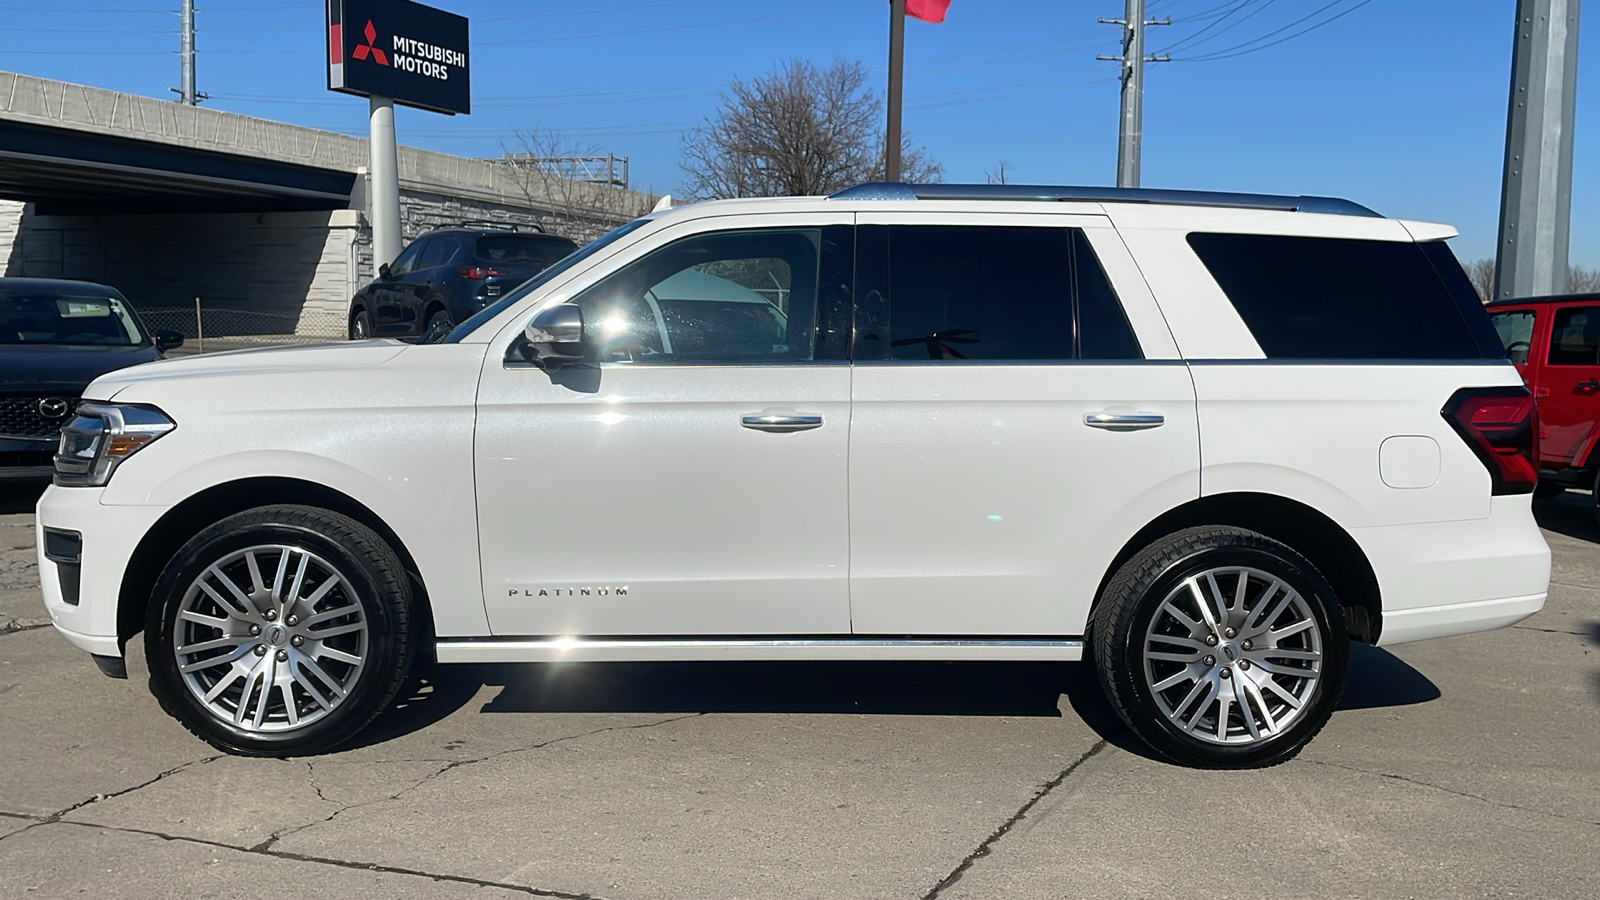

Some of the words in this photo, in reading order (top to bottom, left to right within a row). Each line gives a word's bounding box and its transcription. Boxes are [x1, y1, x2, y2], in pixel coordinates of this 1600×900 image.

[393, 35, 465, 68] MITSUBISHI
[394, 53, 448, 80] MOTORS
[508, 586, 629, 597] PLATINUM
